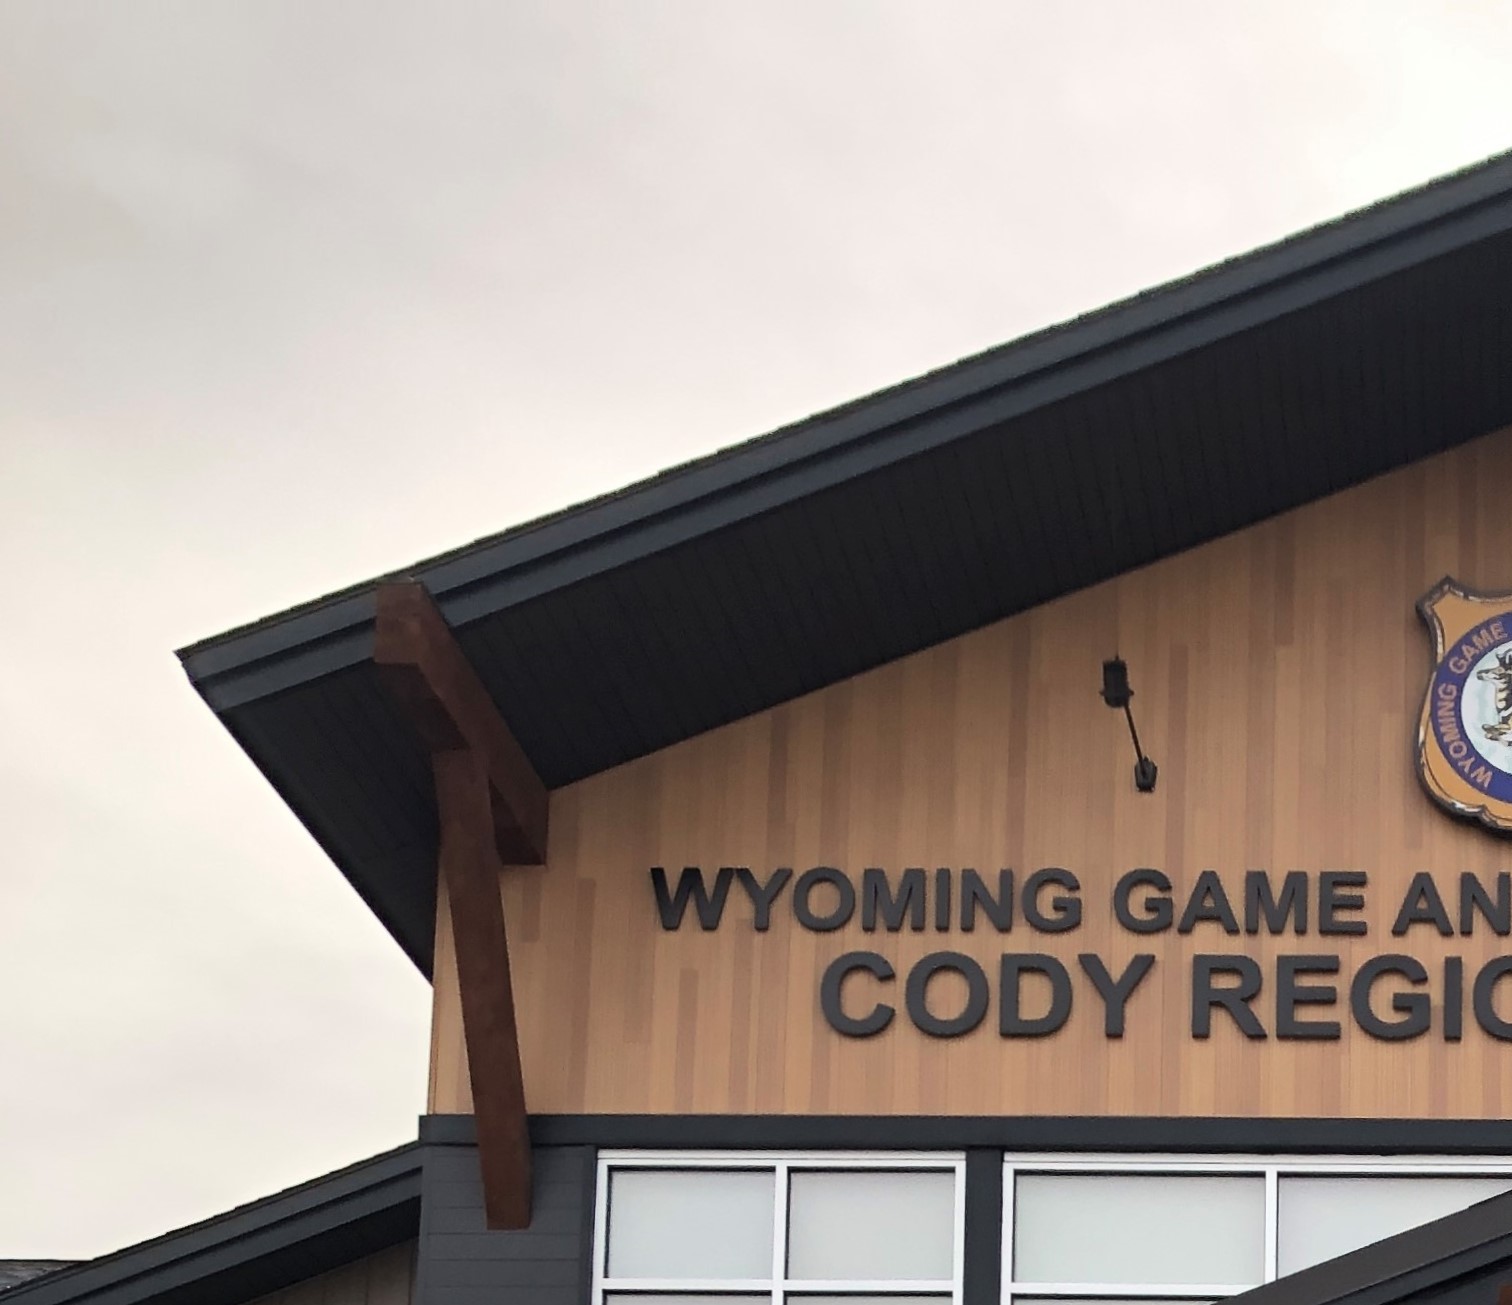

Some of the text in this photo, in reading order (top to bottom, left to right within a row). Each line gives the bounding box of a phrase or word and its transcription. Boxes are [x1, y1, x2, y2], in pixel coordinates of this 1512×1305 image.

[1449, 622, 1508, 674] GAME
[1438, 684, 1493, 788] WYOMING
[650, 866, 1083, 935] WYOMING
[1112, 868, 1368, 936] GAME
[820, 951, 1156, 1040] CODY
